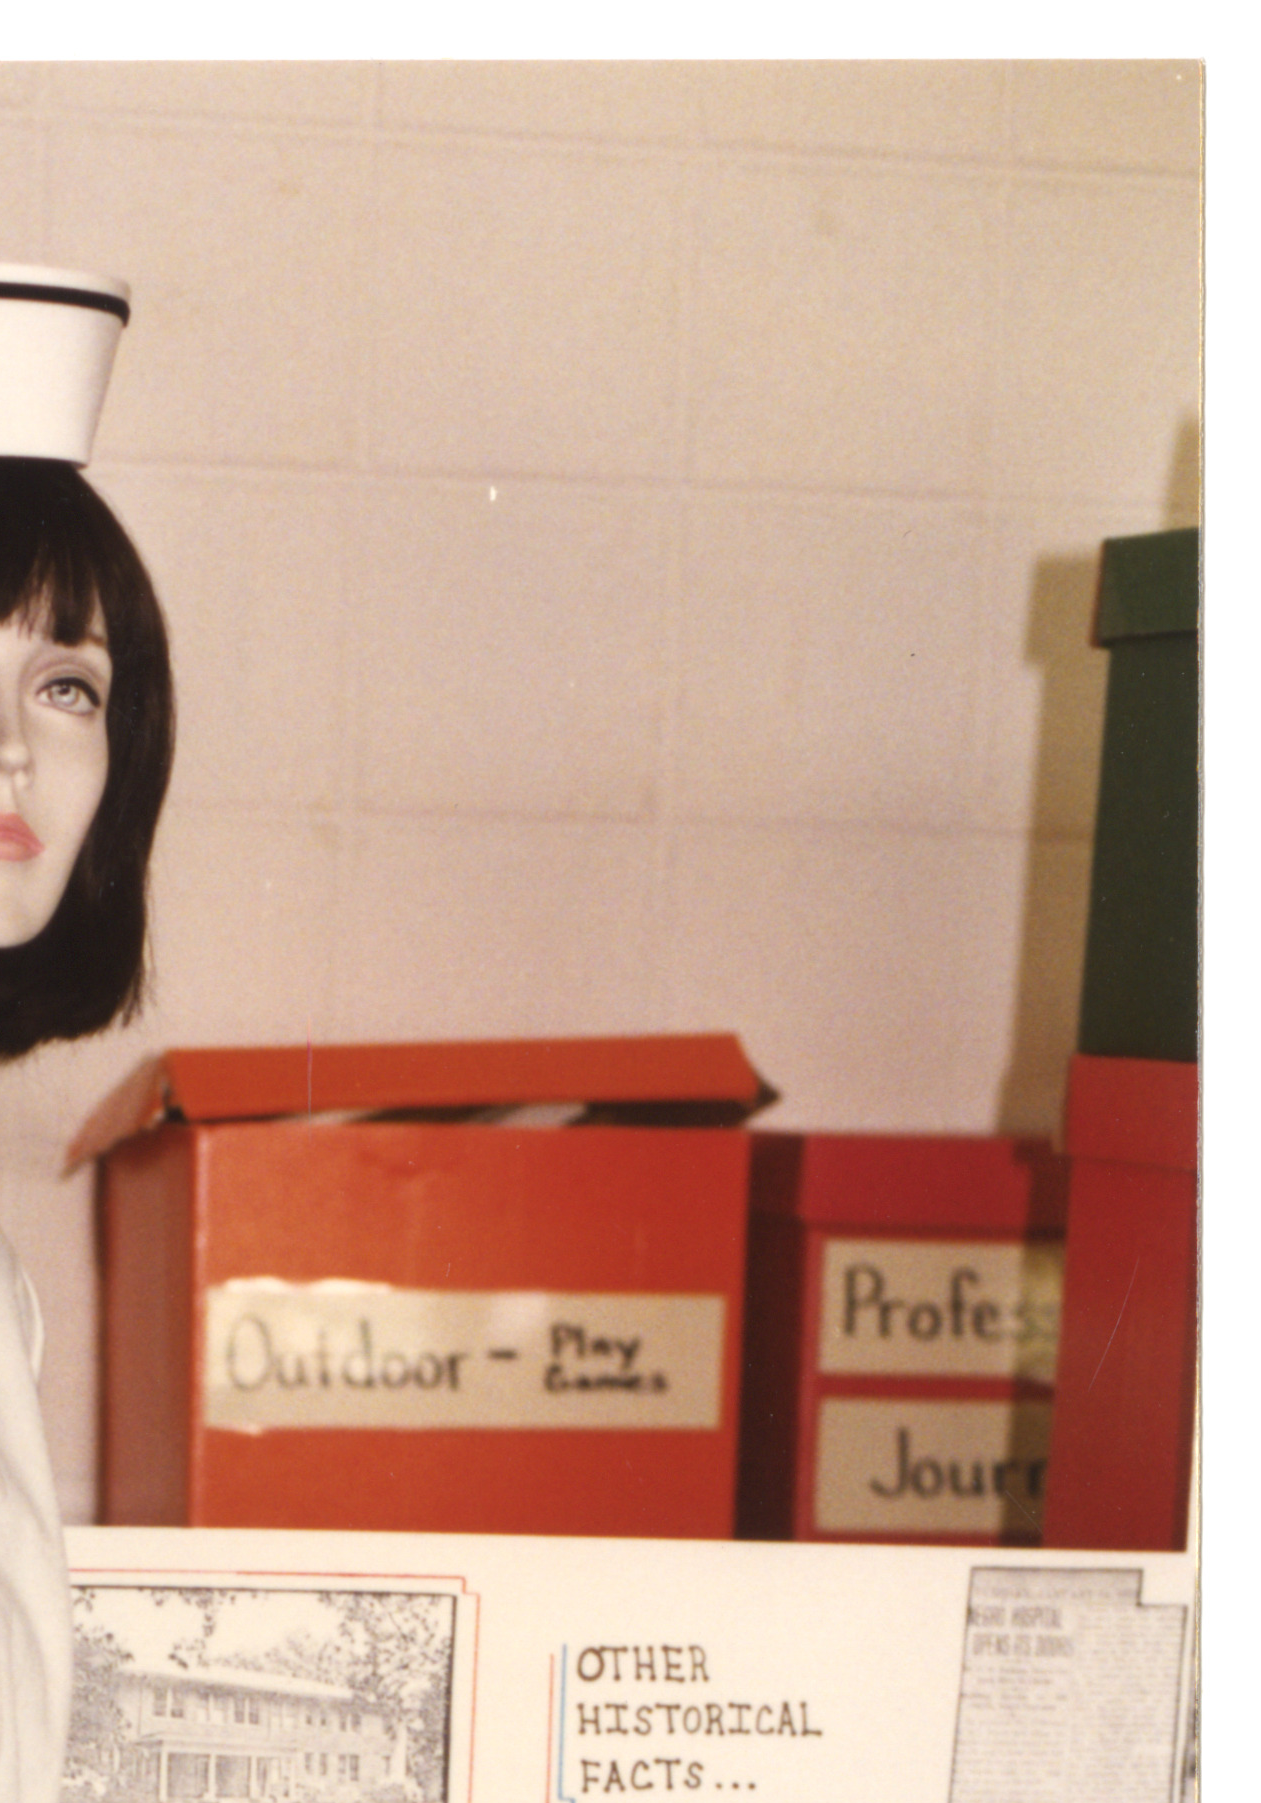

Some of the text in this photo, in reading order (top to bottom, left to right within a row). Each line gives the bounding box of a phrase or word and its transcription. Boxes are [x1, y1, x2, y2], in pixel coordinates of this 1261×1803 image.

[225, 1318, 468, 1396] Outdoor
[550, 1323, 642, 1369] Play
[544, 1363, 669, 1395] Games
[576, 1644, 711, 1684] OTHER
[576, 1701, 824, 1737] HISTORICAL
